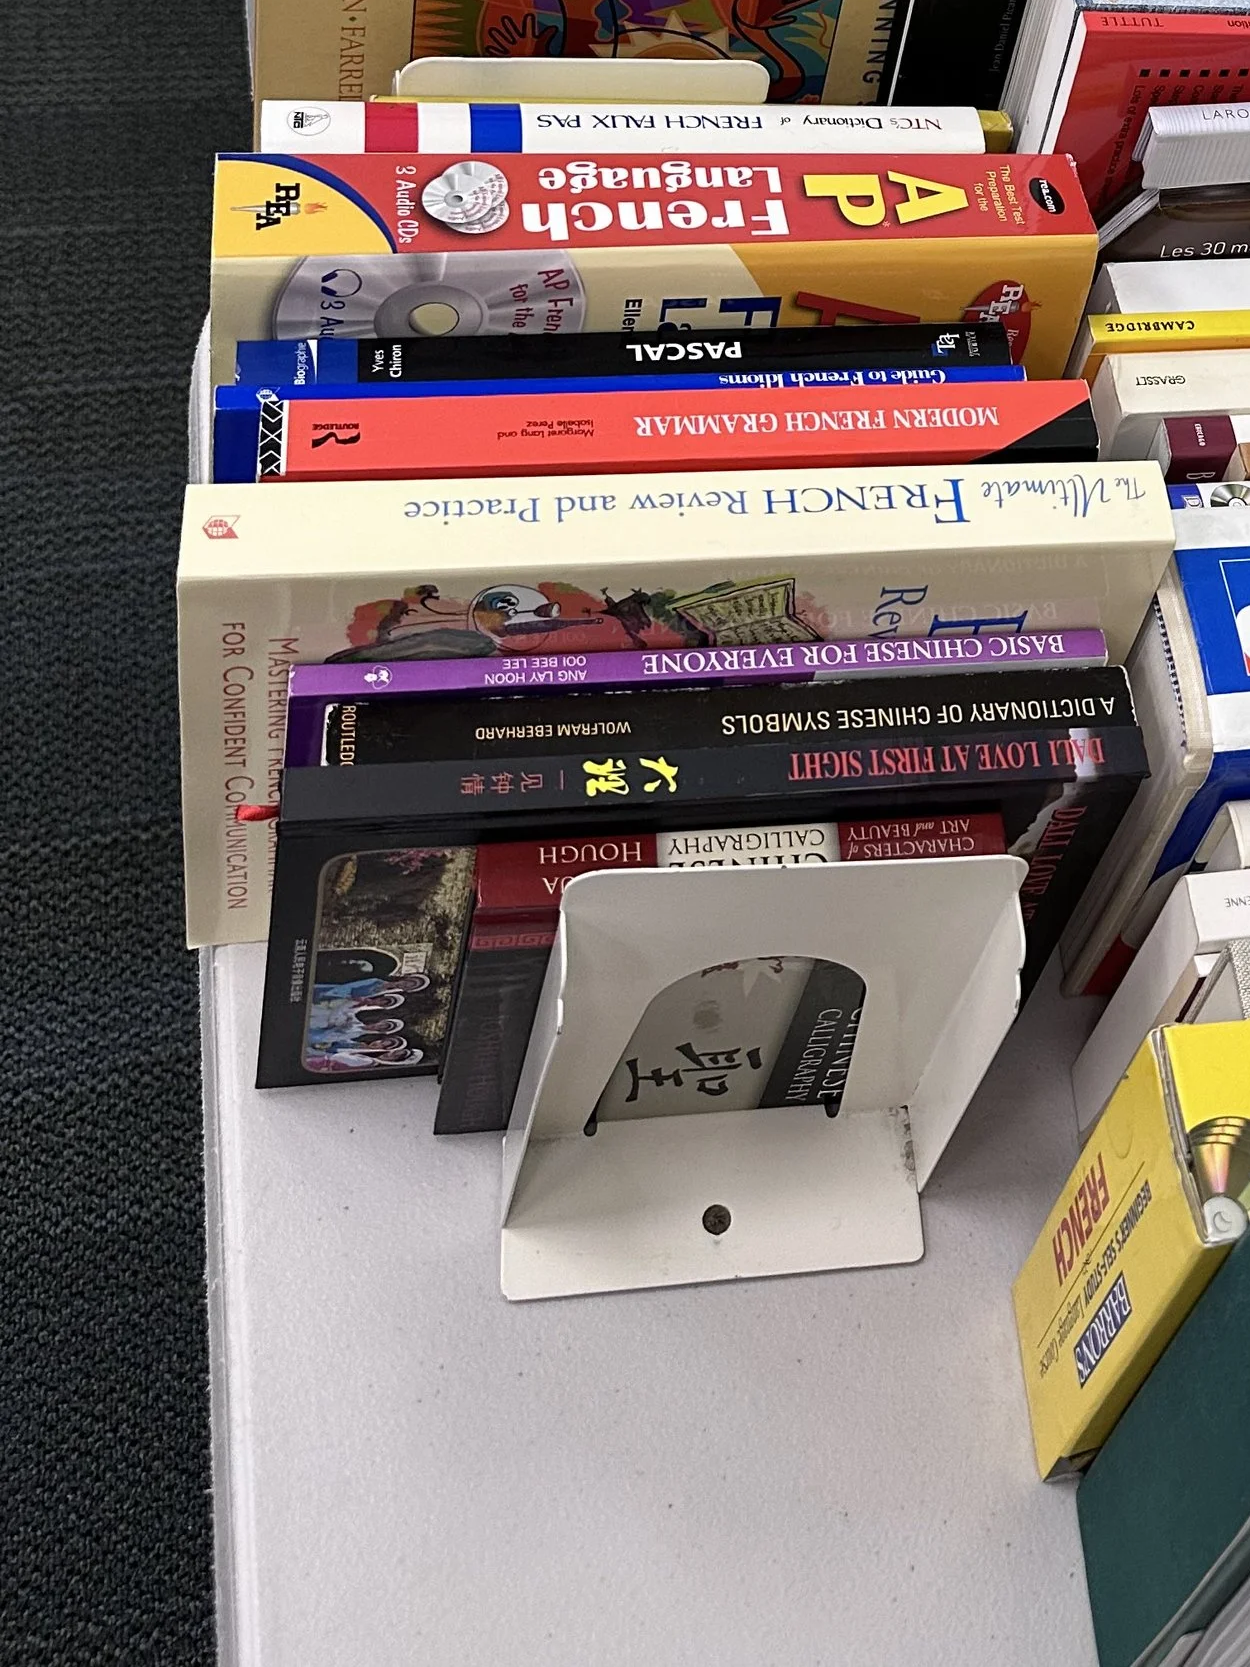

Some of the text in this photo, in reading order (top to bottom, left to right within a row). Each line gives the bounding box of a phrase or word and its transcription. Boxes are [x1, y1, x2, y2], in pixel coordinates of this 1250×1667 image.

[1100, 15, 1164, 28] TUTTLE
[535, 112, 942, 132] NTC's Dictionary of FRENCH FAUX PAS
[538, 162, 781, 196] Language
[1039, 179, 1056, 213] rea.com
[256, 183, 300, 231] REA
[396, 166, 419, 244] 3 Audio CDs
[802, 169, 970, 230] AP
[520, 199, 791, 241] French
[1159, 243, 1195, 258] Les
[1200, 241, 1227, 255] 30
[1104, 319, 1196, 333] CAMBRIDGE
[625, 339, 744, 363] PASCAL
[631, 404, 1001, 438] MODERN FRENCH GRAMMAR
[402, 475, 1145, 528] The Ultimate FRENCH Review and Practice
[641, 633, 1066, 675] BASIC CHINESE FOR EVERYONE
[721, 696, 1115, 736] A DICTIONARY OF CHINESE SYMBOLS
[787, 737, 1105, 781] DALI LOVE AT FIRST SIGHT
[538, 841, 642, 864] HOUGH
[668, 827, 825, 855] CALLIGRAPHY
